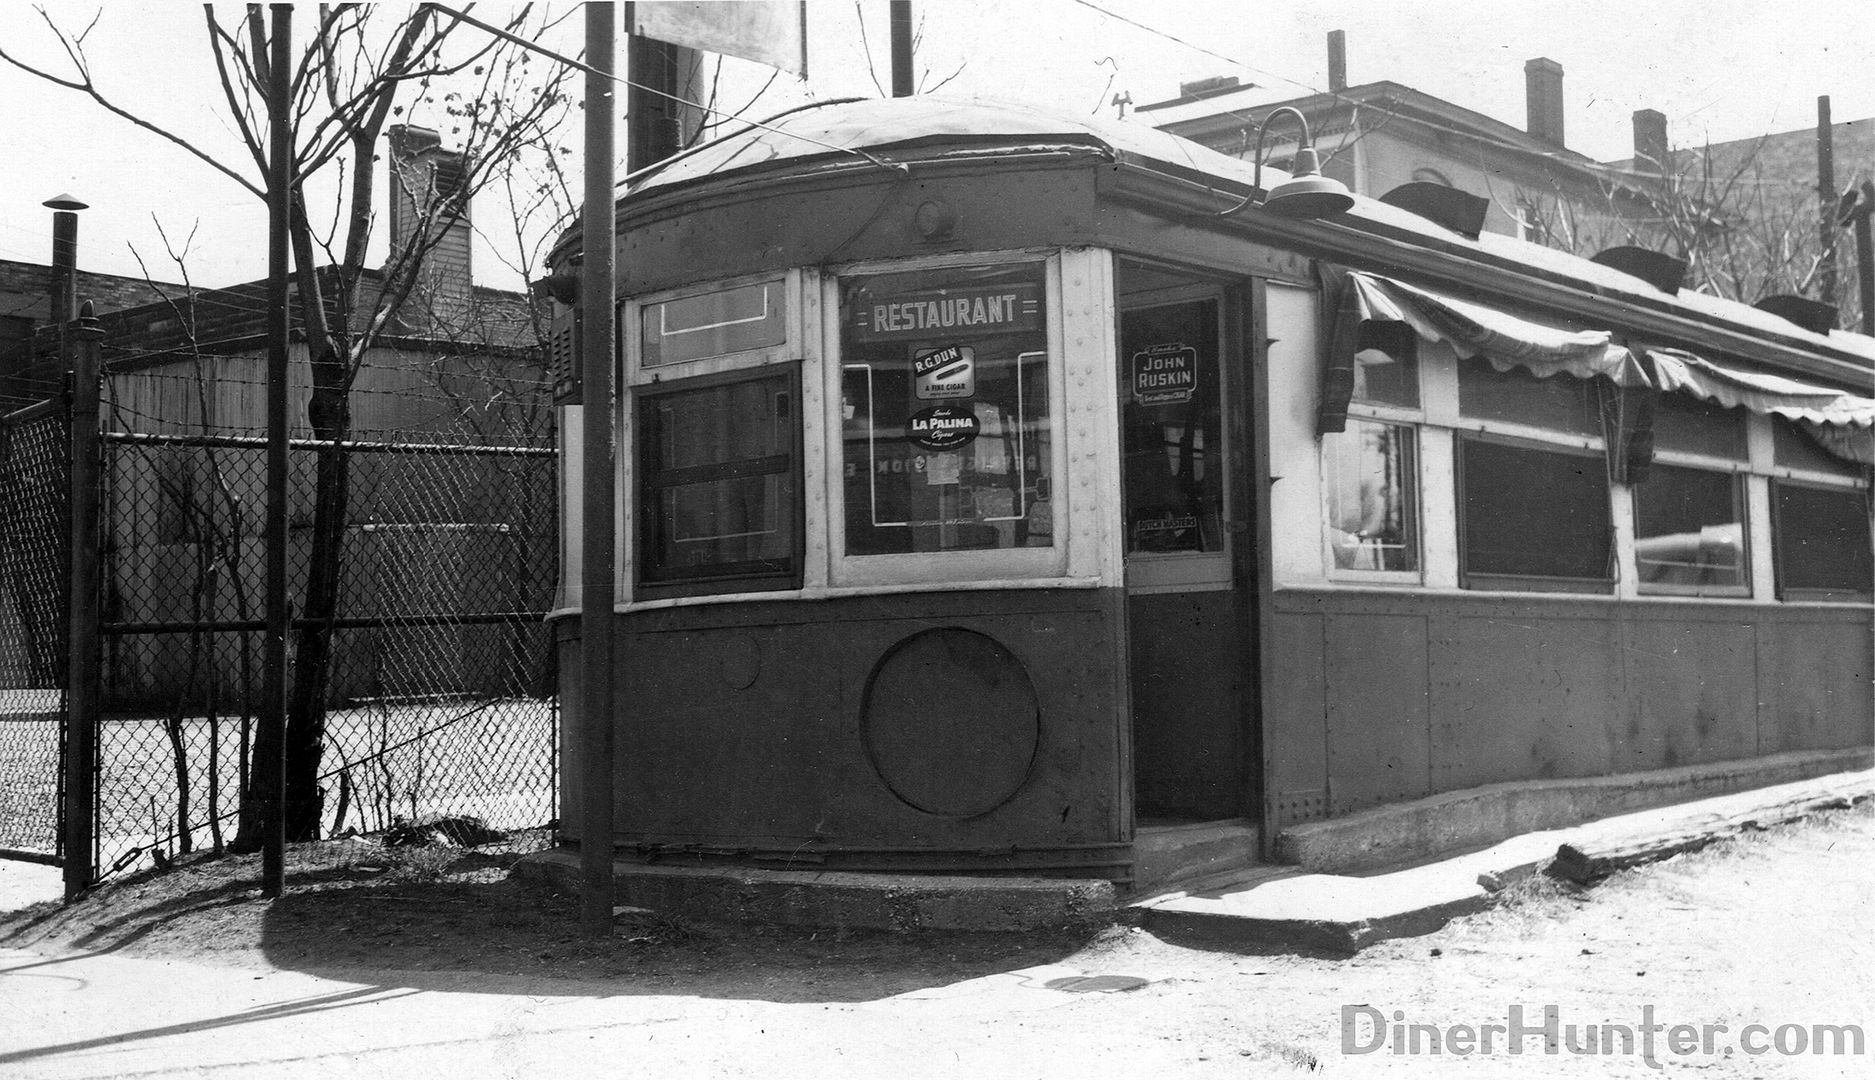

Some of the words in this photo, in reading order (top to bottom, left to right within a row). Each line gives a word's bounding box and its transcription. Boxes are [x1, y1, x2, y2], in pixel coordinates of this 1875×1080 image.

[874, 294, 1016, 332] RESTAURANT
[1143, 356, 1185, 371] JOHN
[1139, 369, 1191, 388] RUSKIN
[912, 419, 928, 430] LA
[929, 418, 973, 429] PALINA
